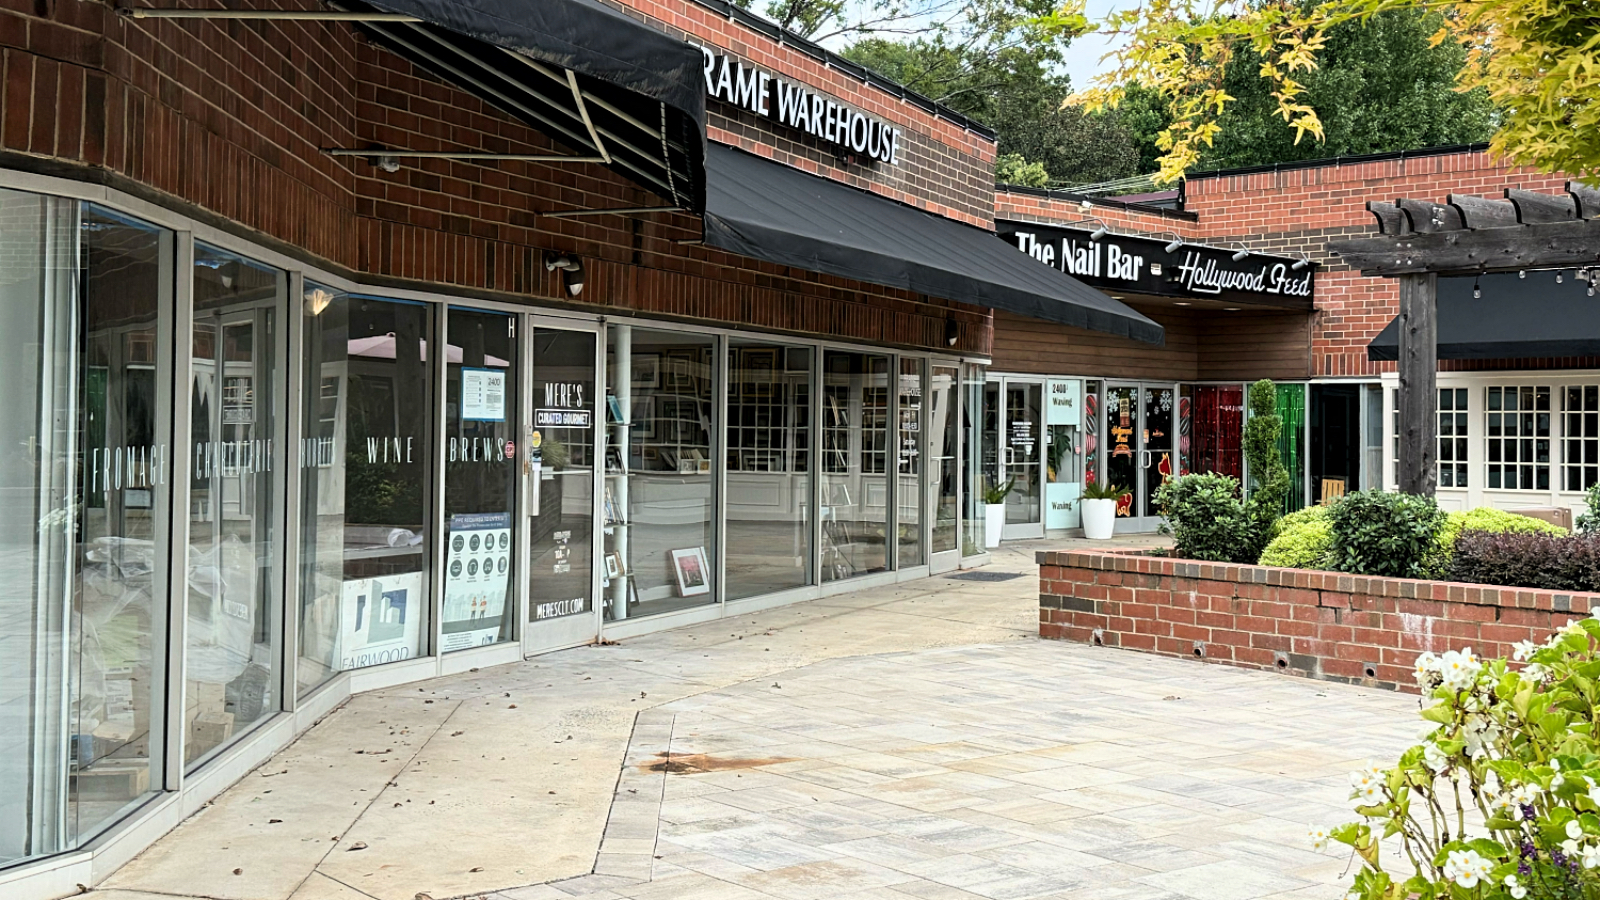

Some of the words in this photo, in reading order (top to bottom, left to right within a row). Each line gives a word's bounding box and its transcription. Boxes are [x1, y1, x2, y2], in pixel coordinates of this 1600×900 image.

[688, 41, 770, 117] RAME
[777, 78, 901, 166] WAREHOUSE
[1015, 231, 1055, 267] The
[1061, 237, 1100, 278] Nail
[1107, 243, 1143, 282] Bar
[1178, 250, 1268, 295] Hollywood
[1266, 262, 1311, 297] Feed
[508, 317, 515, 338] H
[544, 382, 583, 408] MERE'S
[537, 412, 562, 425] CURATED
[562, 412, 588, 425] GOURMET
[367, 436, 414, 464] WINE
[450, 436, 504, 462] BREWS
[92, 444, 166, 493] FROMAGE
[536, 598, 584, 619] MERESCLT.COM
[342, 646, 409, 669] FAIRWOOD
